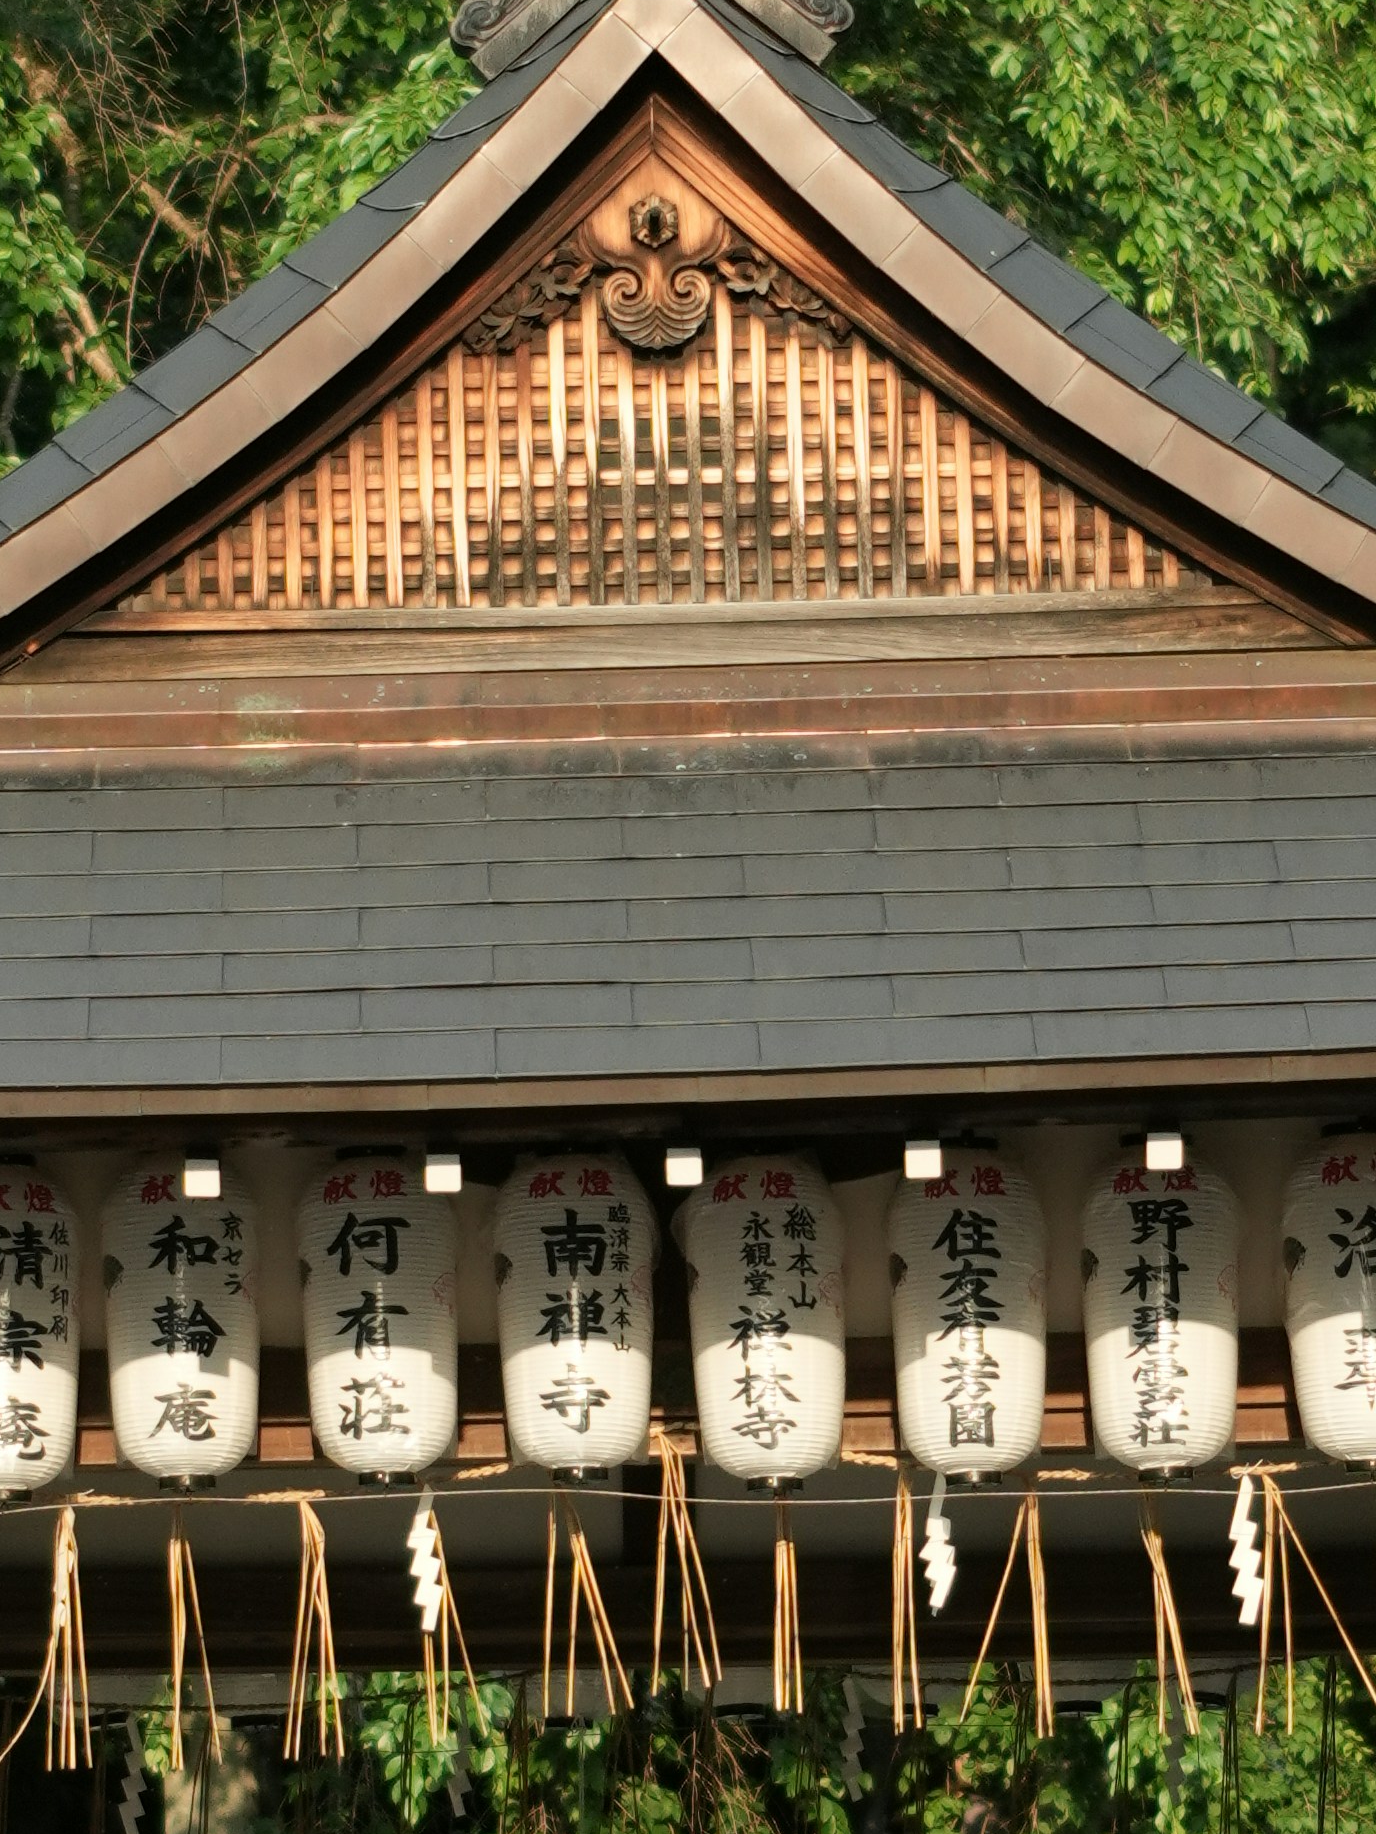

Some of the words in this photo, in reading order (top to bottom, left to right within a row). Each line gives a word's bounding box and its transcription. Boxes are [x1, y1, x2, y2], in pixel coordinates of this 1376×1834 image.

[323, 1170, 408, 1205] 献燈
[529, 1168, 615, 1198] 献燈
[712, 1169, 798, 1203] 献燈
[924, 1166, 1007, 1199] 献燈
[1112, 1166, 1199, 1193] 献燈
[49, 1220, 70, 1344] 佐川印刷
[220, 1211, 243, 1295] 京セラ
[782, 1203, 818, 1311] 総本山
[148, 1215, 227, 1441] 和輪庵
[327, 1212, 412, 1440] 何有荘
[536, 1208, 612, 1435] 南禅寺
[931, 1208, 1006, 1448] 住友有芳園
